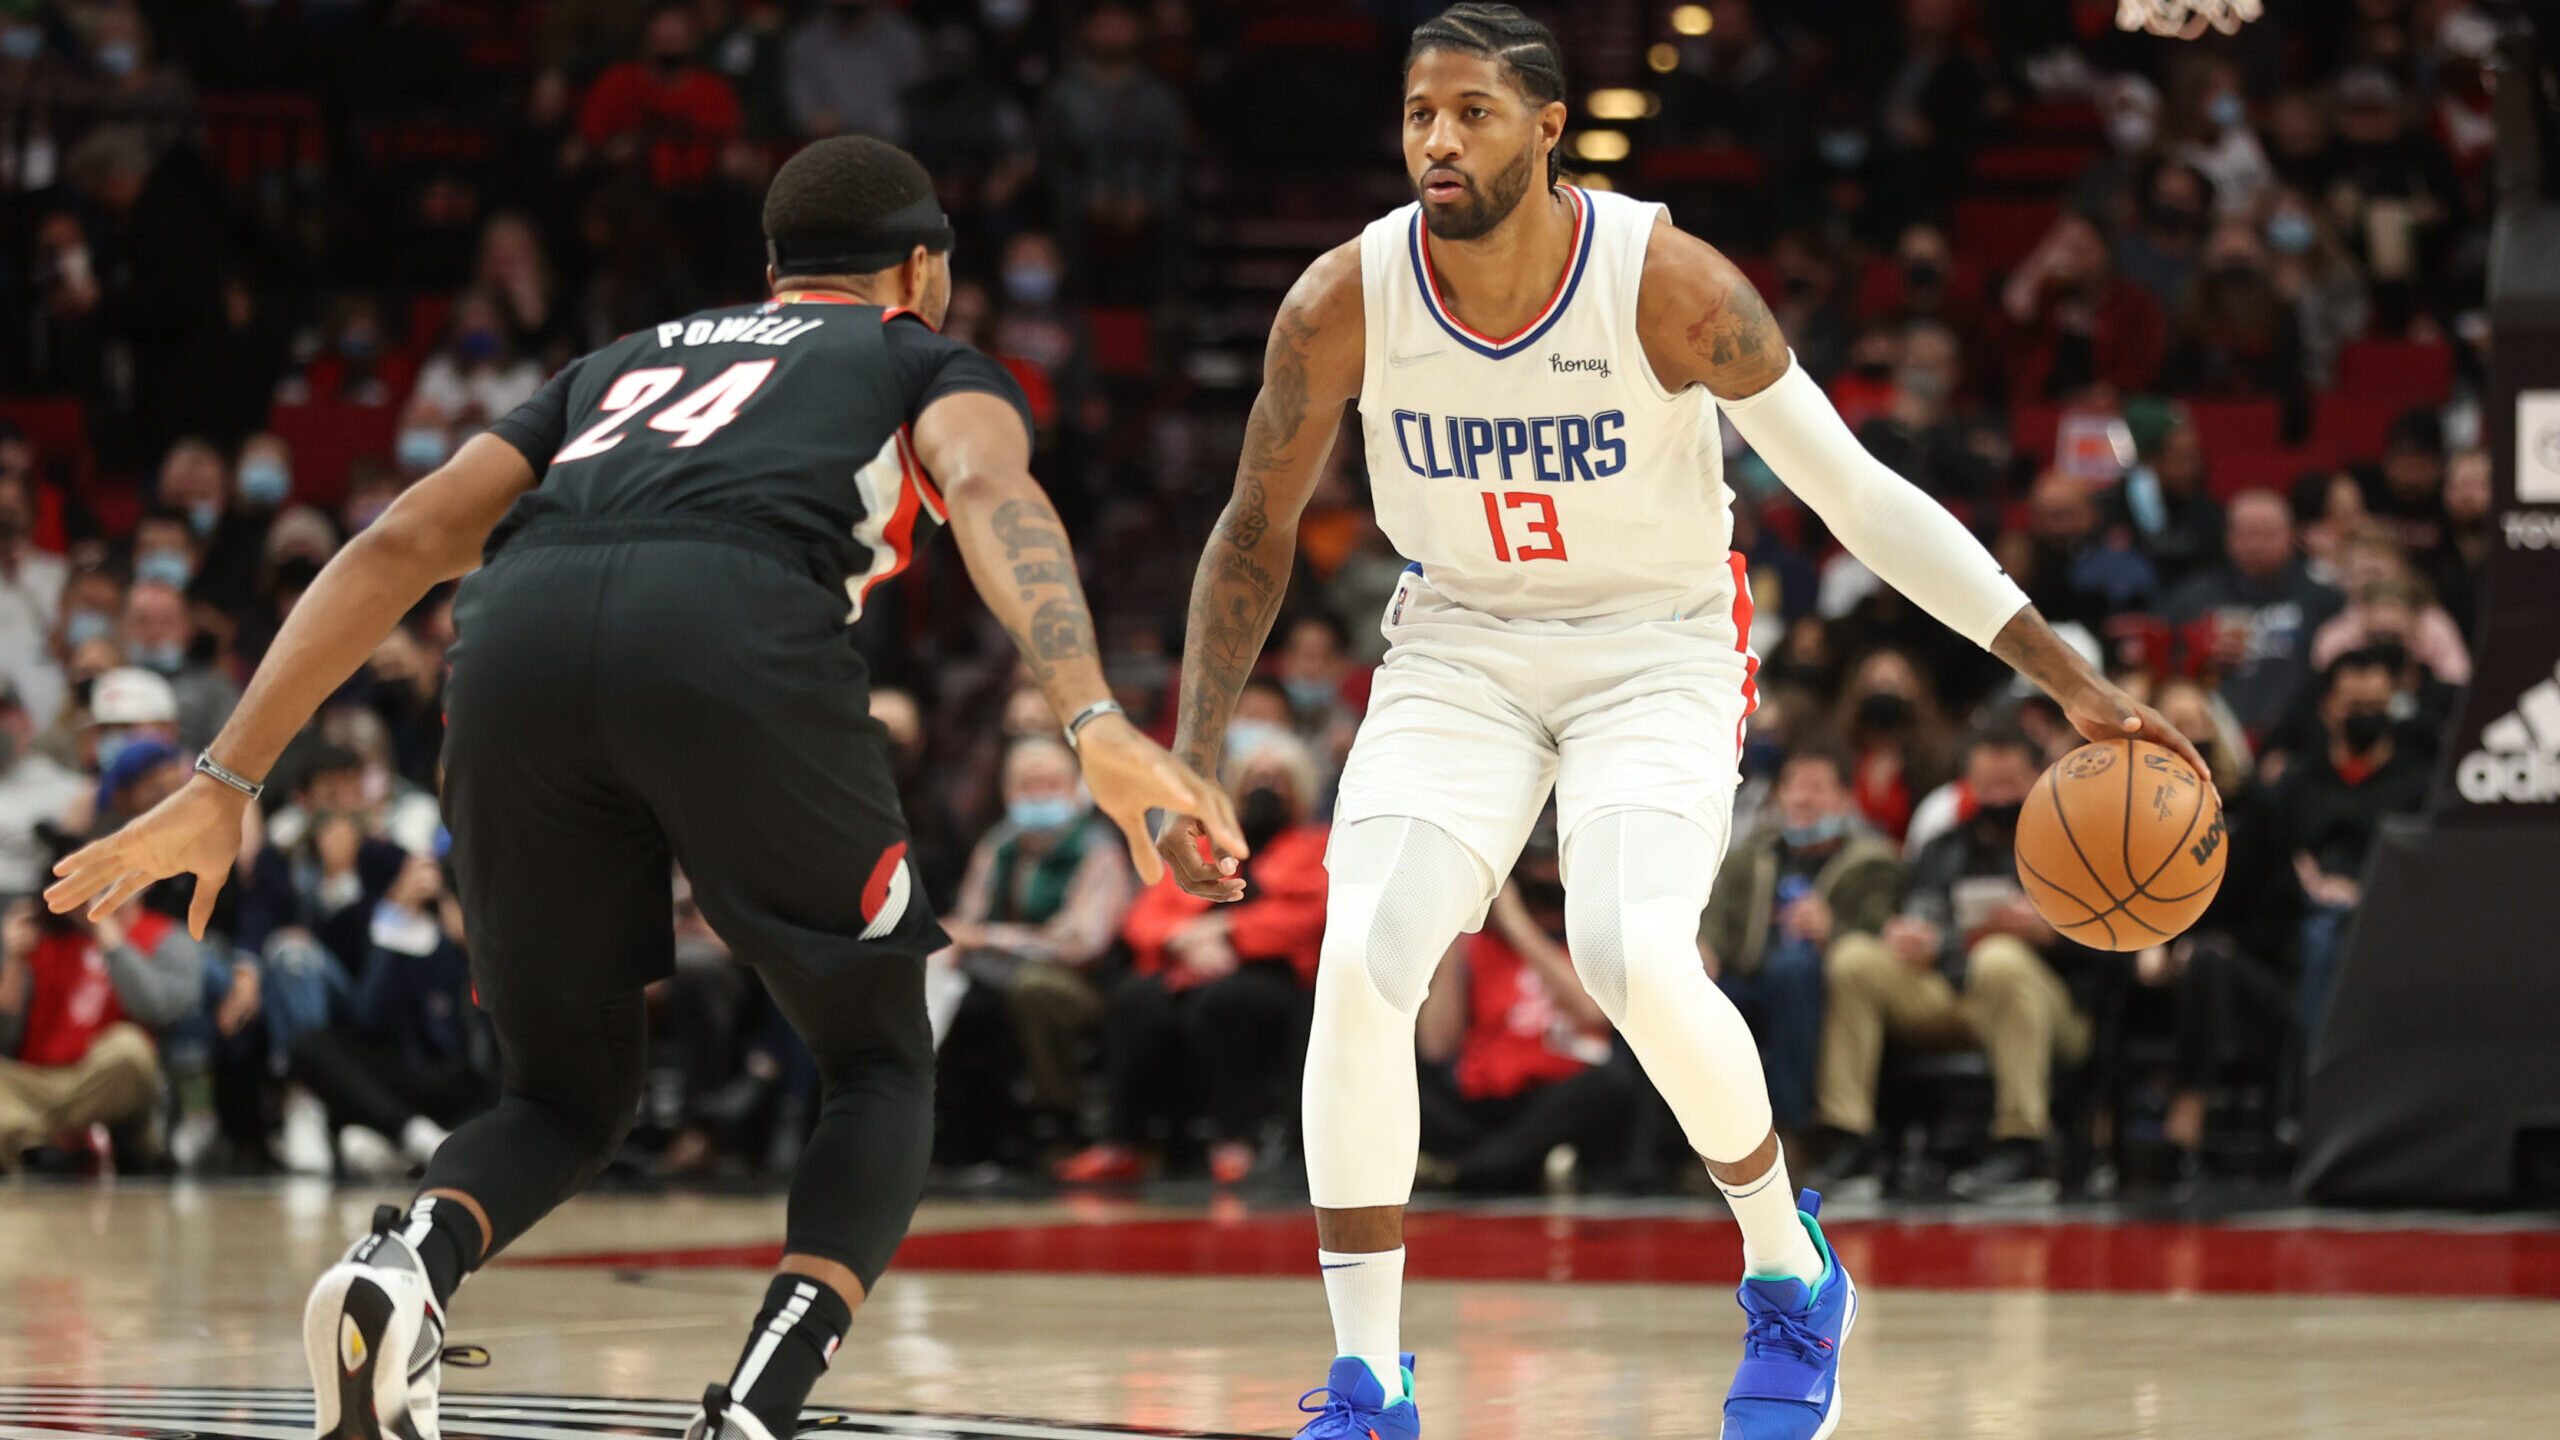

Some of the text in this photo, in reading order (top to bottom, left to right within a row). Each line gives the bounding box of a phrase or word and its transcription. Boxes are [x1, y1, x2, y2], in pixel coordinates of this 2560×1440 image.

[657, 315, 825, 348] POWELL
[1549, 353, 1611, 378] honey
[551, 357, 777, 464] 24
[1391, 409, 1626, 482] CLIPPERS
[1481, 491, 1568, 562] 13
